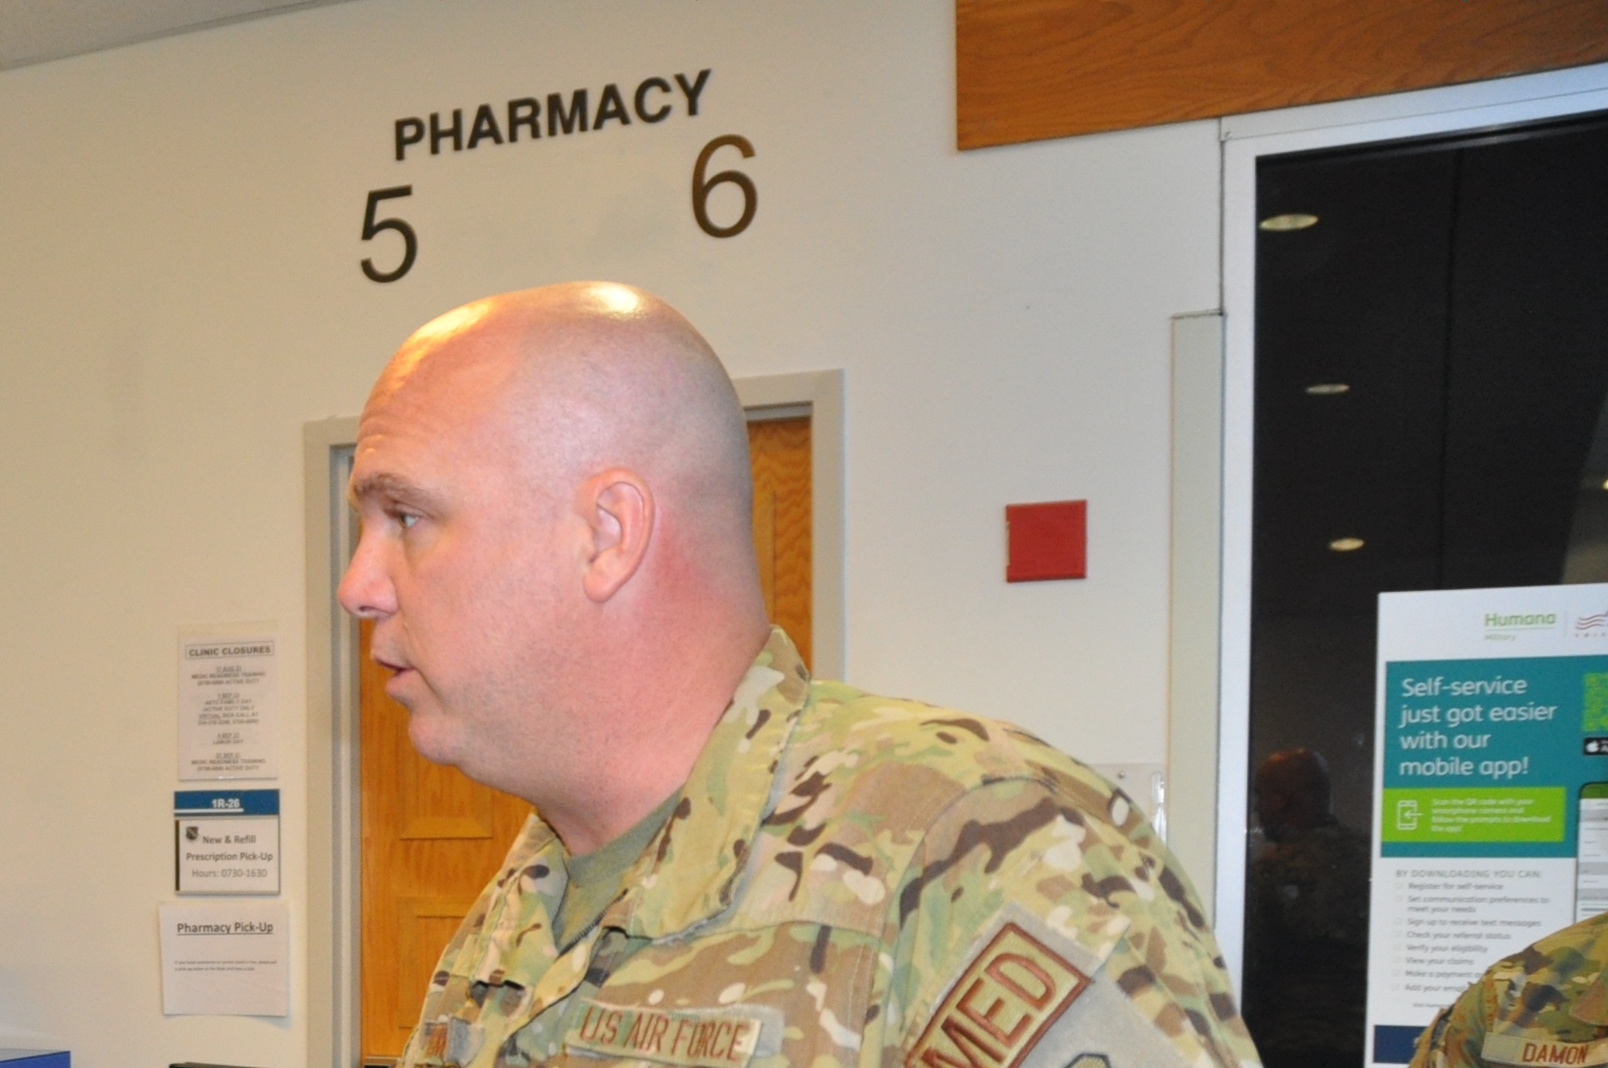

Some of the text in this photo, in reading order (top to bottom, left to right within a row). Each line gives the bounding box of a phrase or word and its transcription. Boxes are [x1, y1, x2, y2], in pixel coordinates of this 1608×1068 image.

[395, 68, 712, 161] PHARMACY
[691, 134, 758, 238] 6
[360, 184, 418, 283] 5
[1484, 613, 1557, 627] Humana
[189, 645, 271, 657] CLINIC CLOSURES
[1401, 676, 1528, 697] Self-service
[1398, 702, 1557, 728] just got easier
[1400, 731, 1491, 750] with our
[1399, 757, 1529, 780] mobile app!
[212, 798, 240, 809] 1R-26
[202, 835, 256, 844] New & Refill
[186, 852, 273, 863] Prescription Pick-Up
[192, 868, 220, 878] Hours:
[1396, 870, 1408, 878] BY
[1411, 870, 1490, 878] DOWNLOADING
[1494, 870, 1515, 878] YOU
[1408, 882, 1504, 891] Register for self-service
[1431, 907, 1450, 915] your
[177, 922, 274, 934] Pharmacy Pick-Up
[1433, 932, 1451, 940] your
[623, 1012, 670, 1052] AIR
[671, 1018, 750, 1062] FORCE
[1522, 1043, 1590, 1065] DAMON
